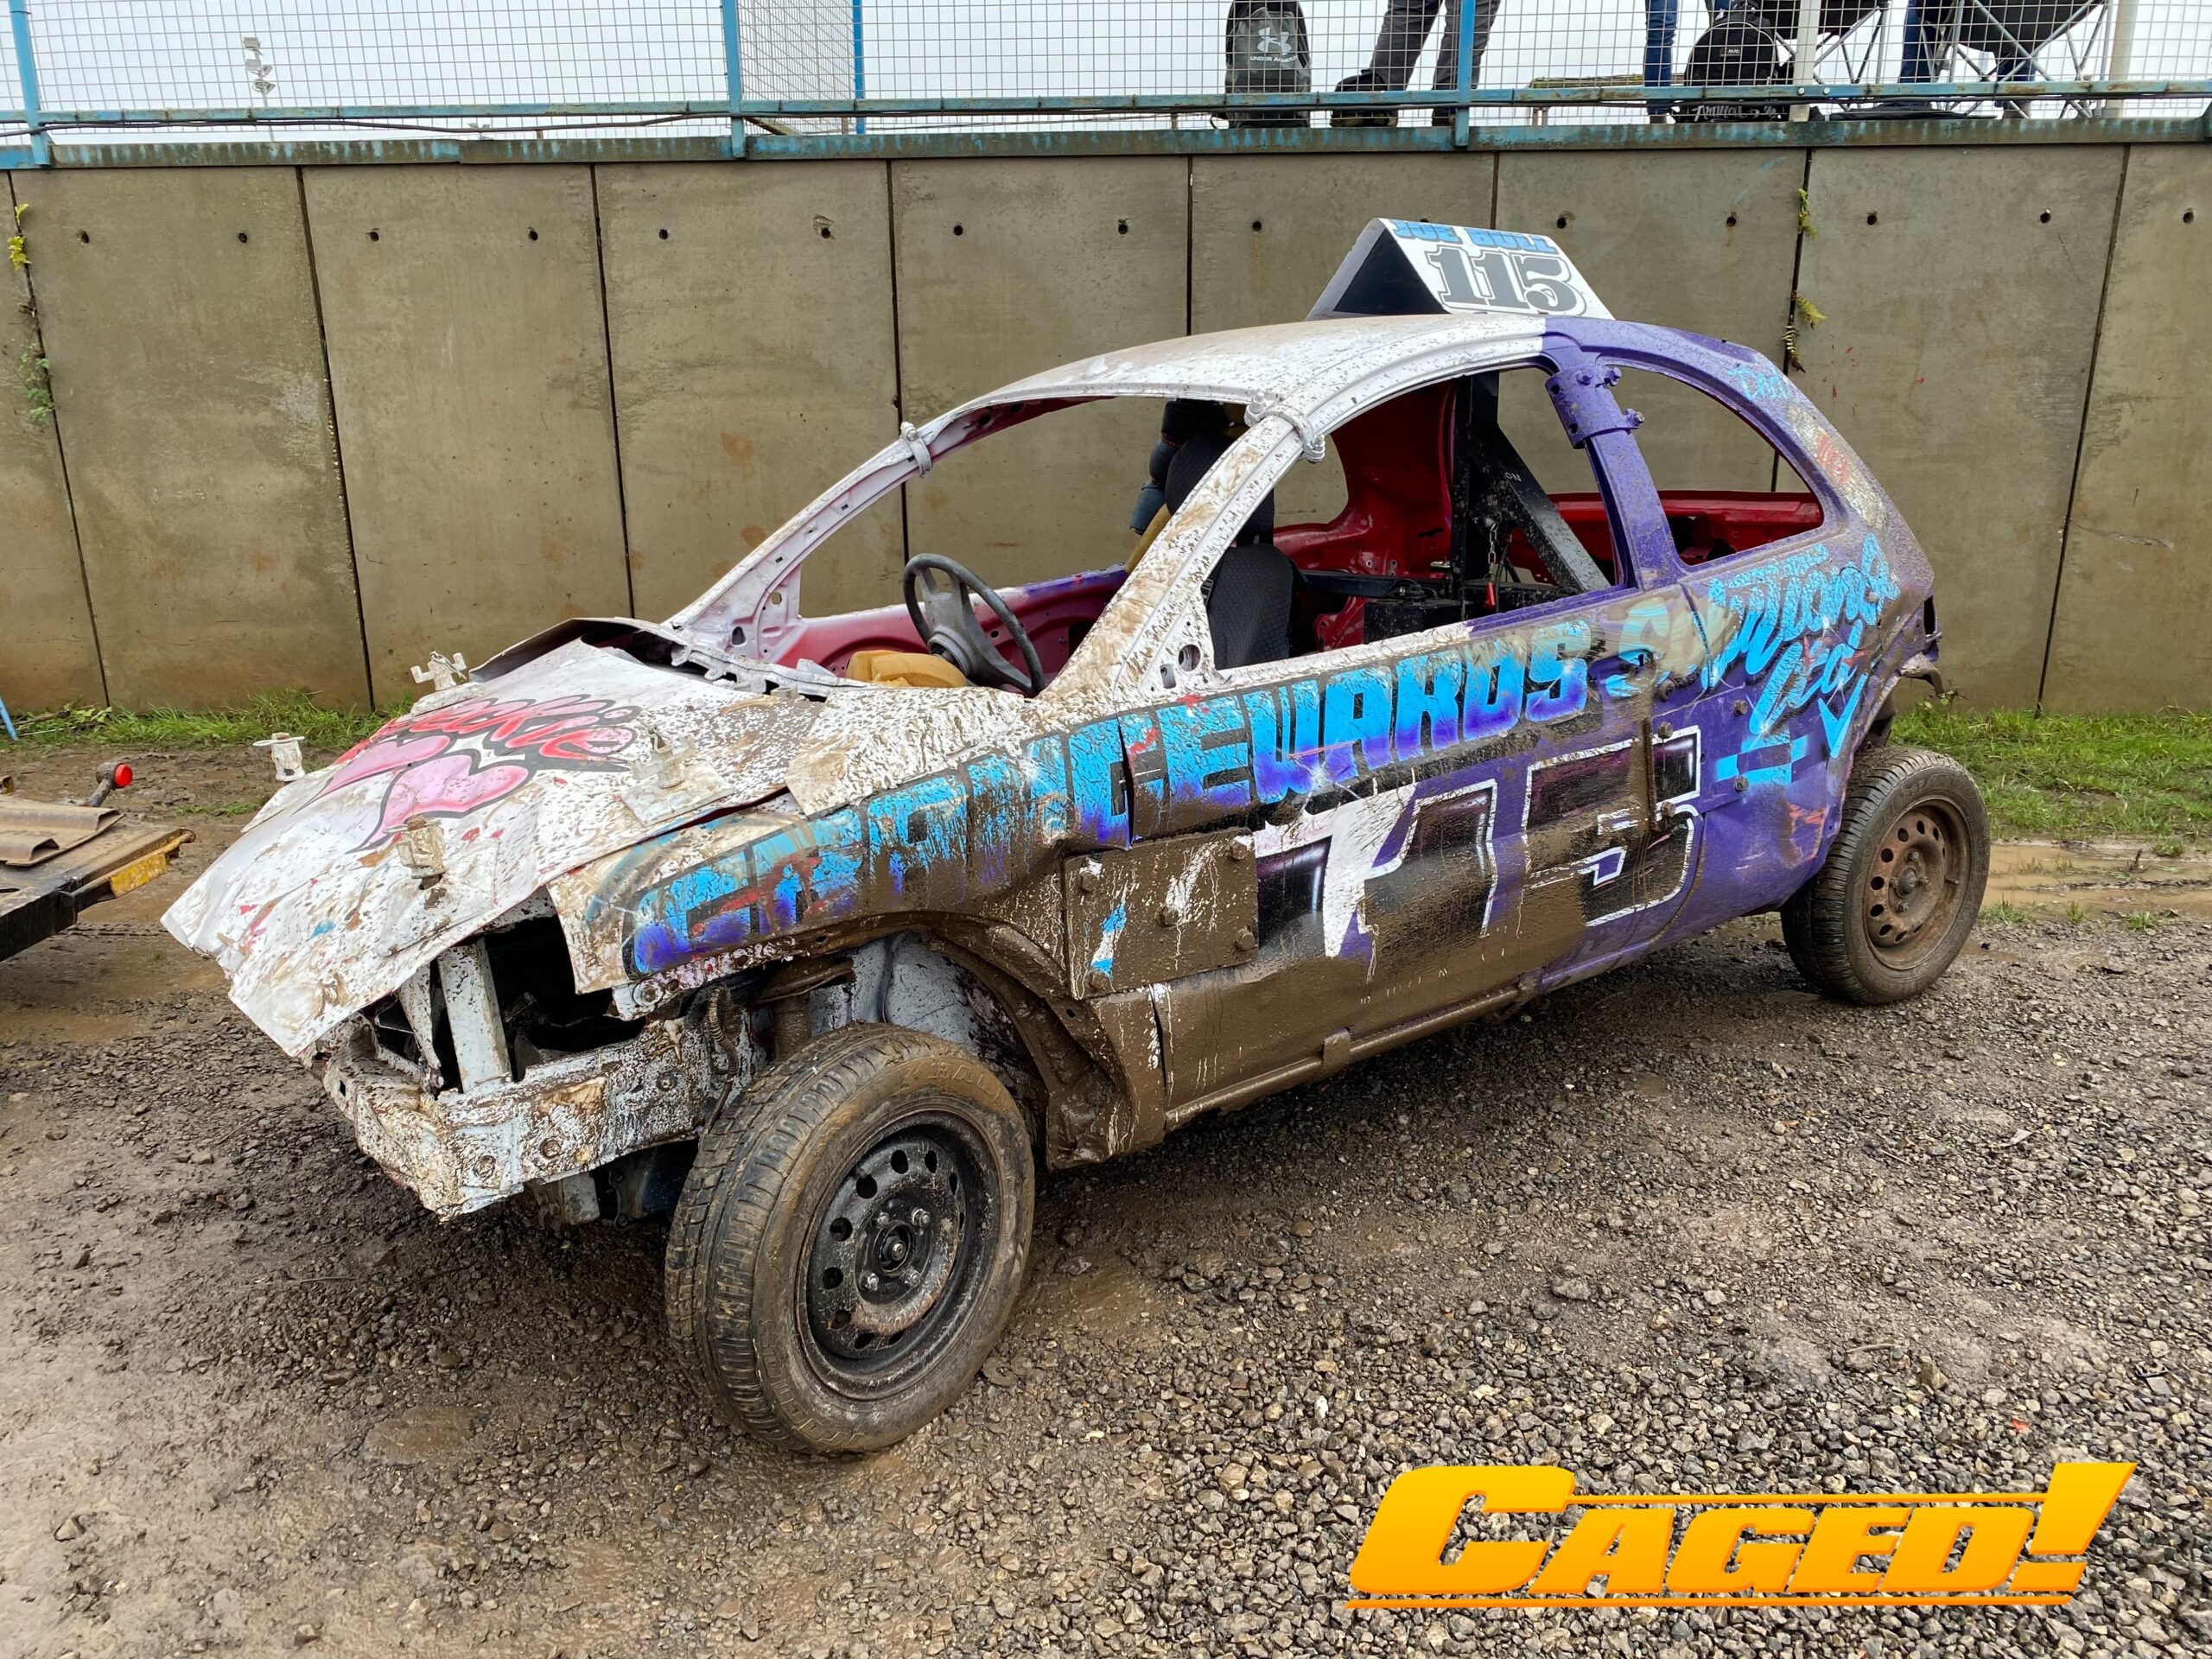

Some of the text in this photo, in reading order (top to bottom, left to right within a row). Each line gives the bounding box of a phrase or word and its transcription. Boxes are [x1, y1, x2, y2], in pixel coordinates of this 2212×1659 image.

[1273, 54, 1299, 63] ARMOU
[1392, 219, 1559, 255] JOE BULL
[1425, 244, 1587, 316] 115
